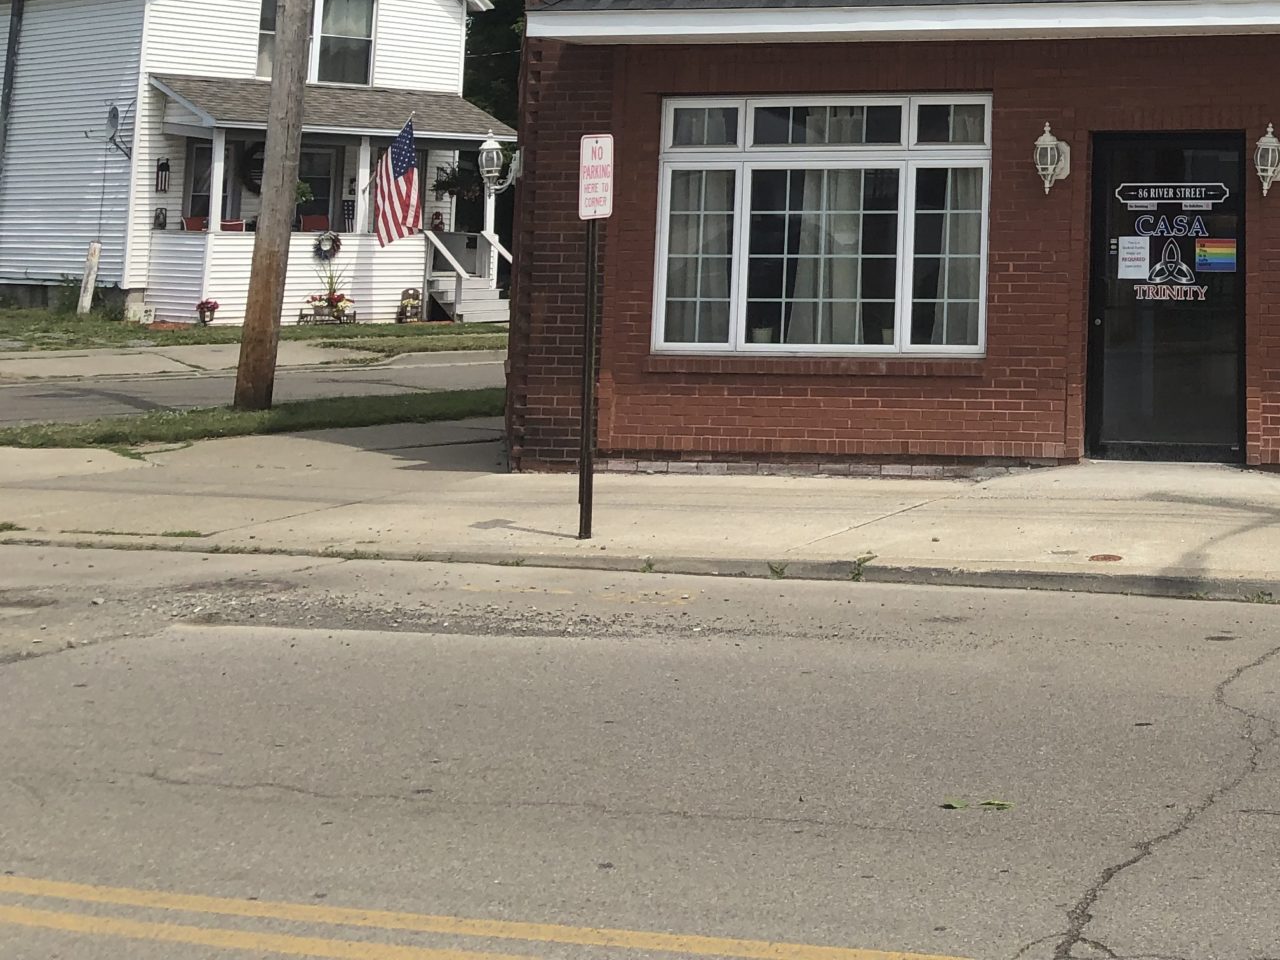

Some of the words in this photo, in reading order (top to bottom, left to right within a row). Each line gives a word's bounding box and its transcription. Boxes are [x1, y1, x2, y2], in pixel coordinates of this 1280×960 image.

[591, 146, 604, 161] NO
[582, 164, 611, 180] PARKING
[584, 183, 599, 194] HERE
[601, 182, 609, 193] TO
[1138, 188, 1148, 198] 86
[1150, 188, 1174, 198] RIVER
[1175, 187, 1206, 198] STREET
[584, 196, 607, 208] CORNER
[1134, 214, 1209, 237] CASA
[1133, 284, 1208, 301] TRINITY
